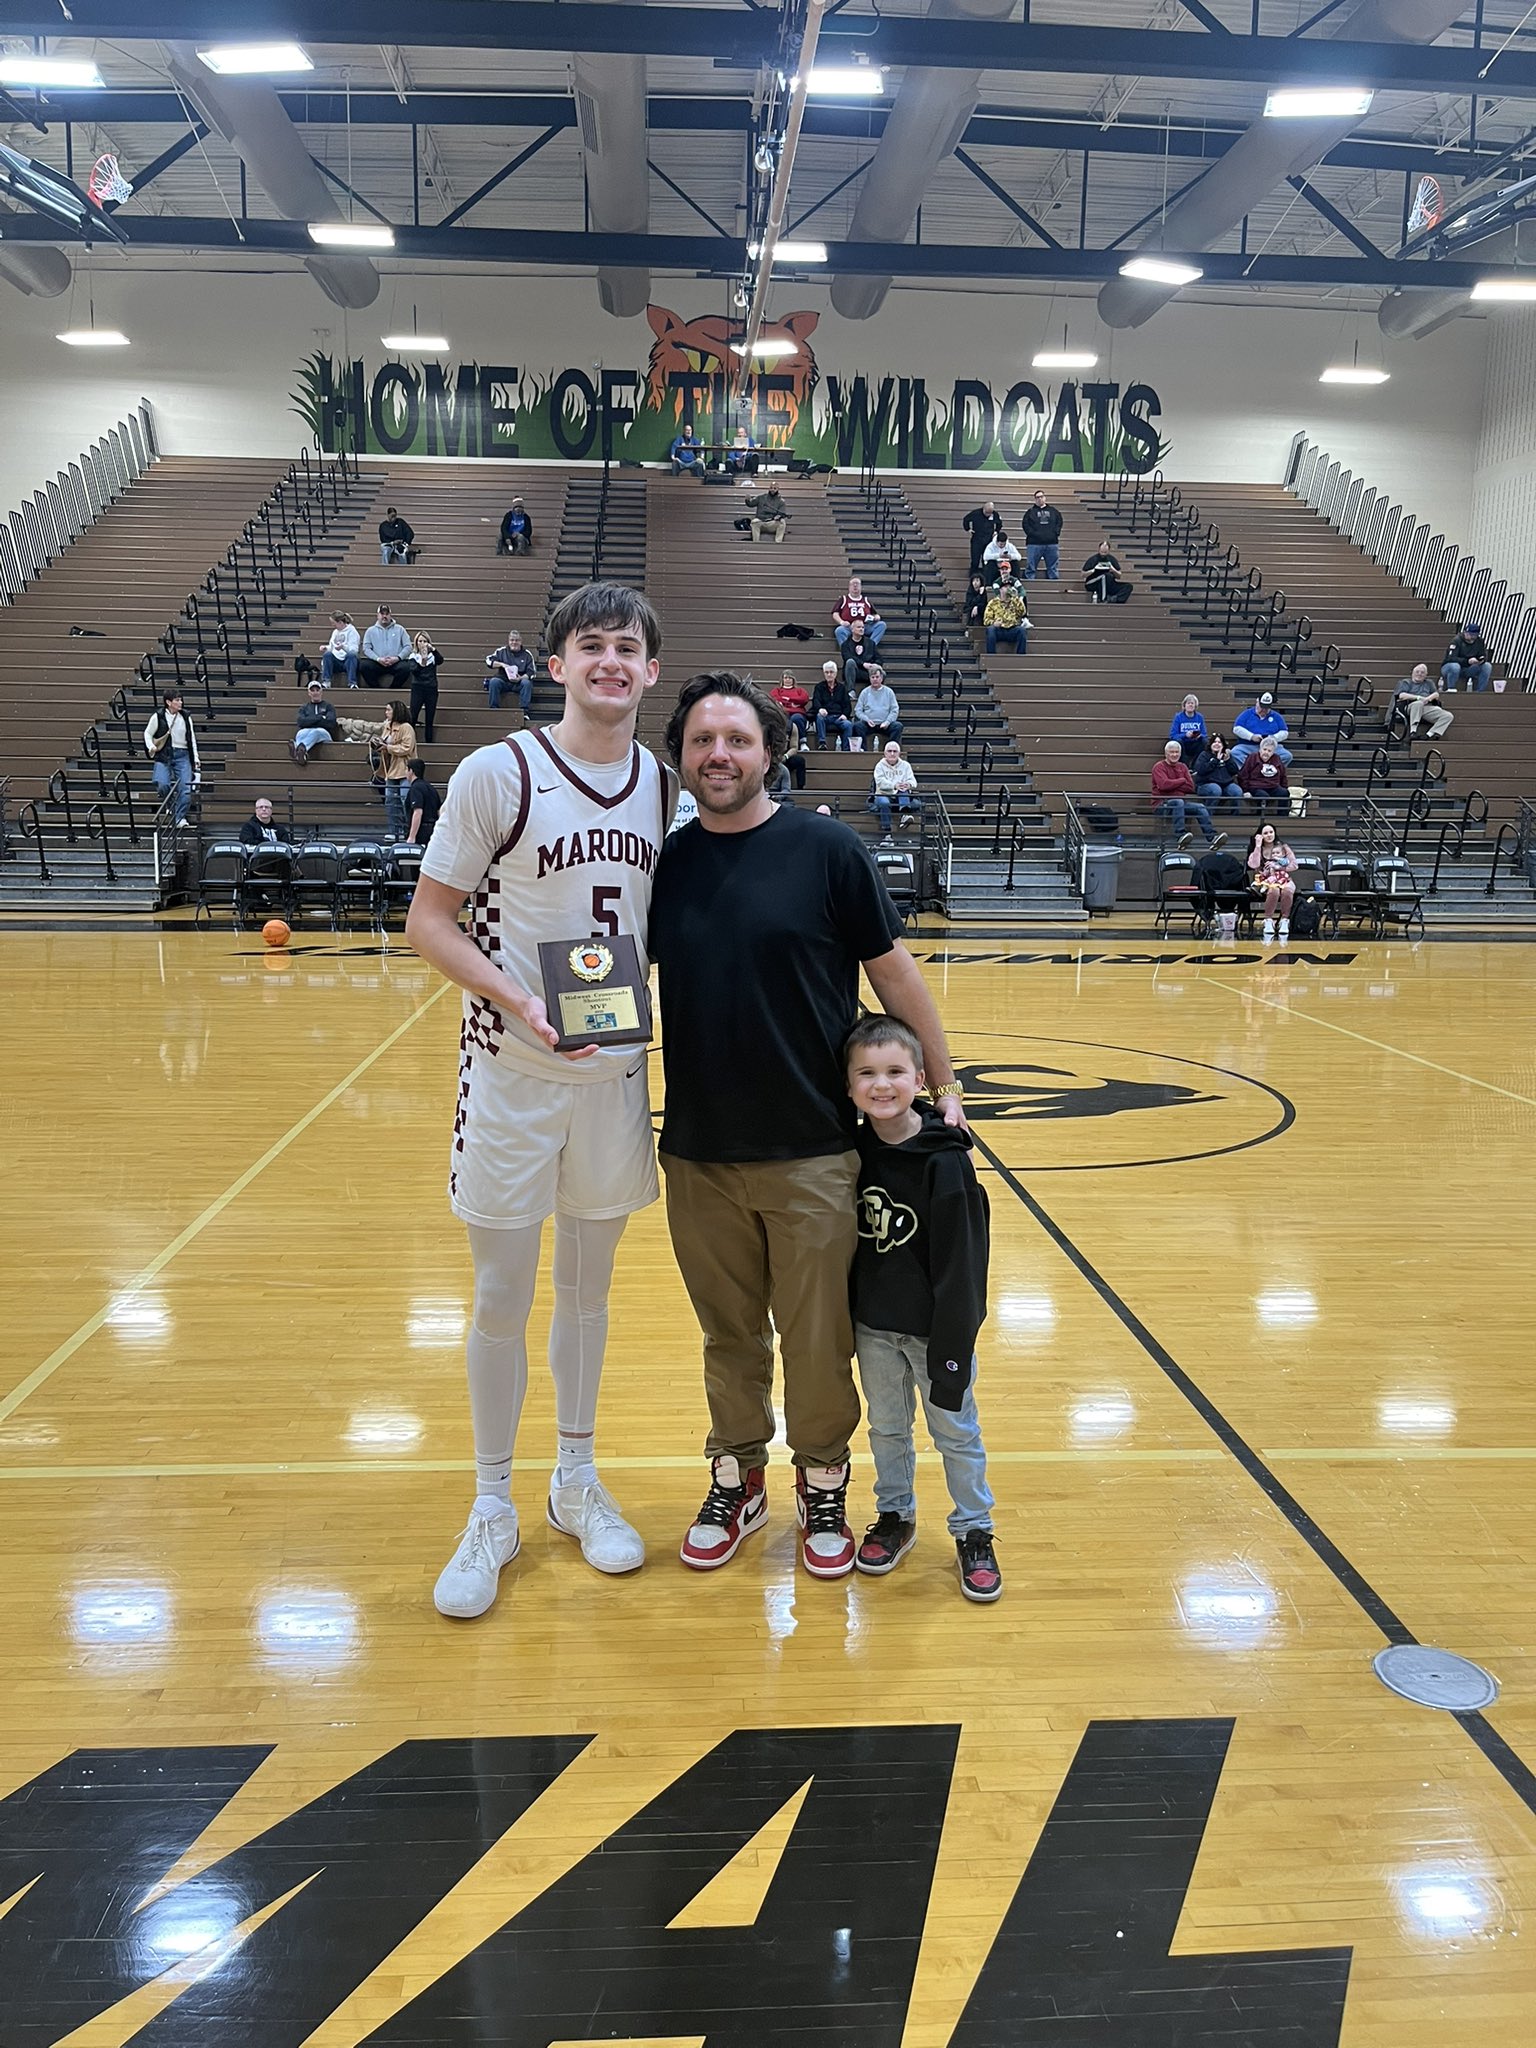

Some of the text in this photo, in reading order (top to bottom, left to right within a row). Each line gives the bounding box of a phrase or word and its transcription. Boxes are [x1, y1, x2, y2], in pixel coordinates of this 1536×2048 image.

[320, 359, 1162, 475] HOME OF THE WILDCATS
[590, 885, 622, 937] 5
[911, 953, 1359, 965] NORMA
